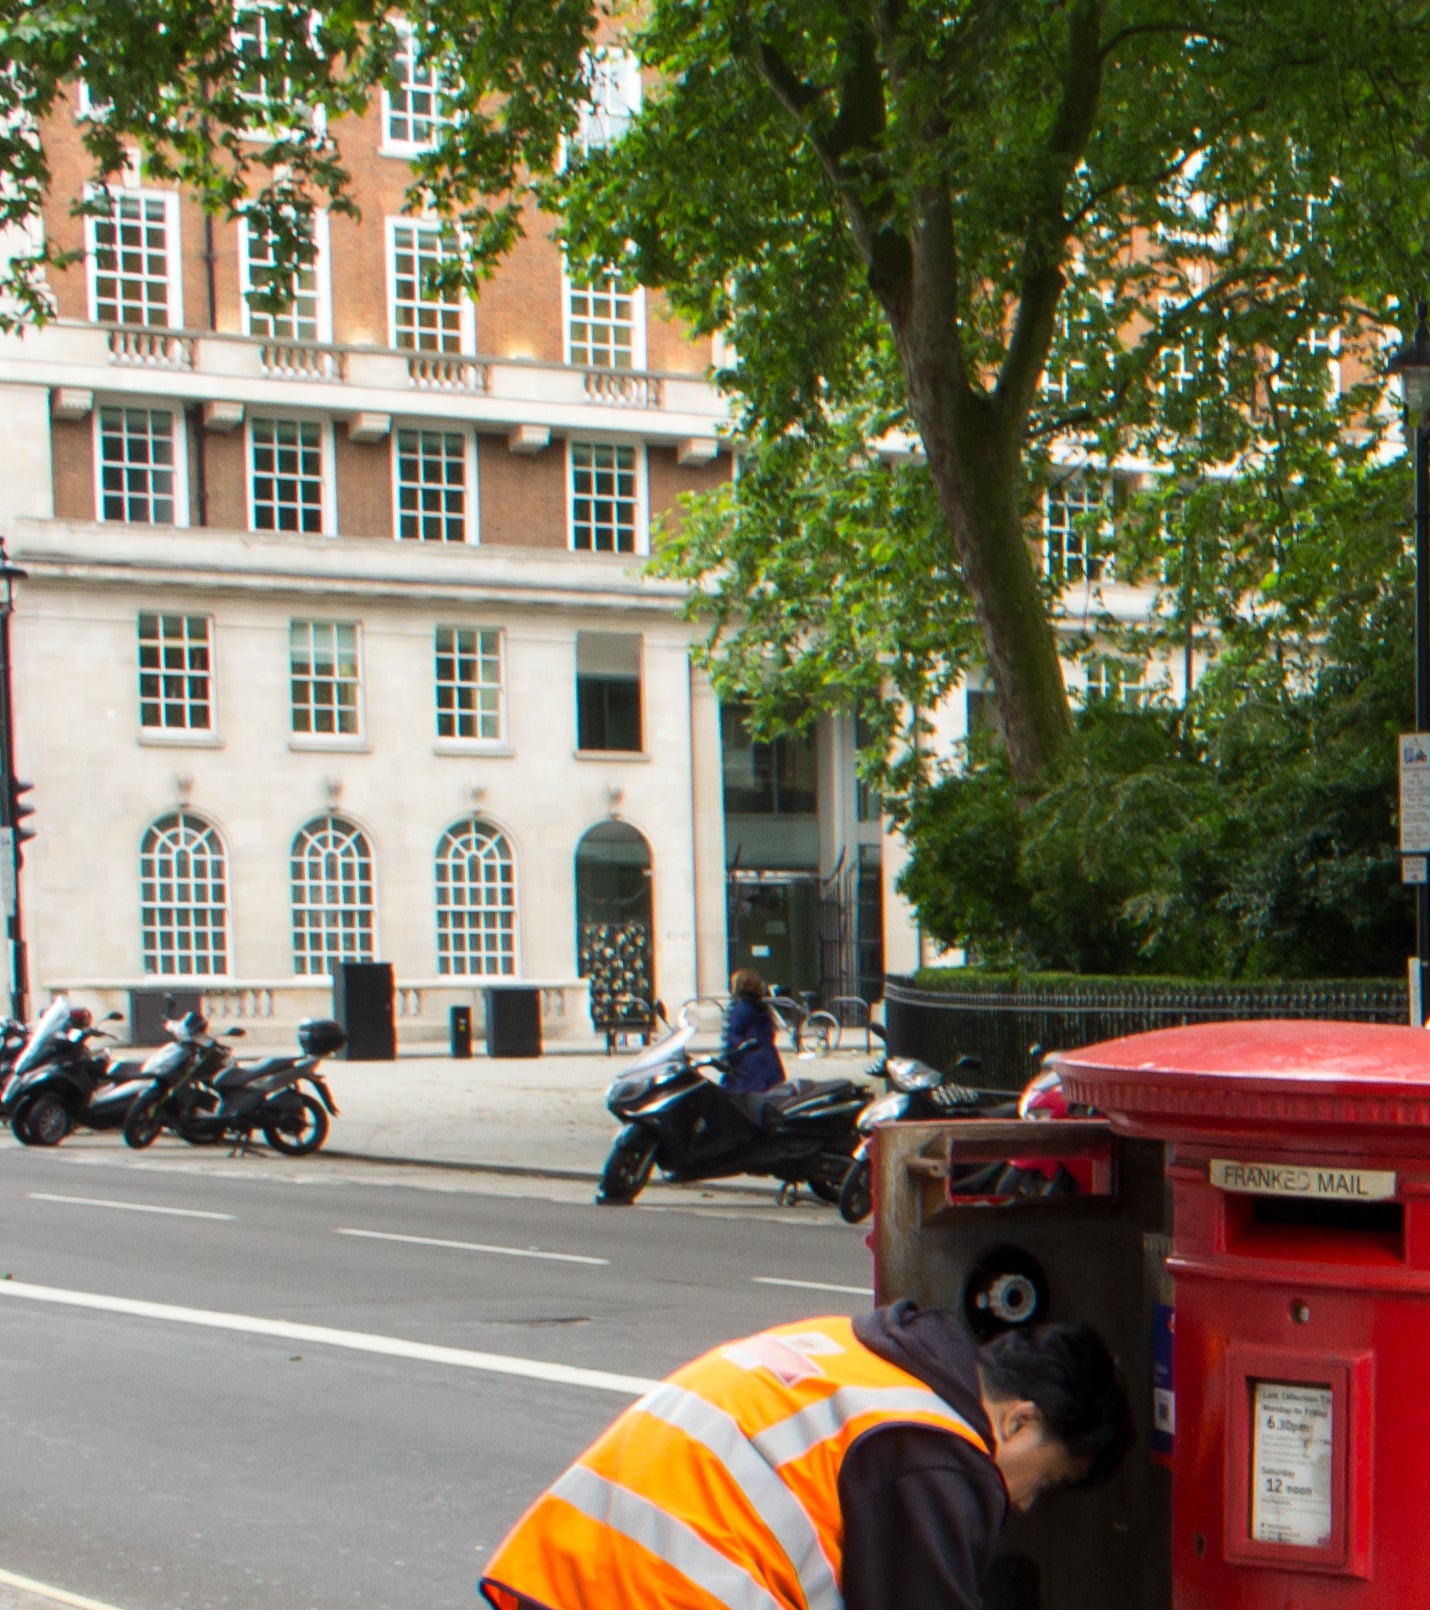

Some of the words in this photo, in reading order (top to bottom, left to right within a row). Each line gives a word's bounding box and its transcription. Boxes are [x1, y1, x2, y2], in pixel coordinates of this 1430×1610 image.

[1223, 1164, 1311, 1191] FRANKED
[1317, 1172, 1369, 1195] MAIL
[1265, 1478, 1283, 1494] 12
